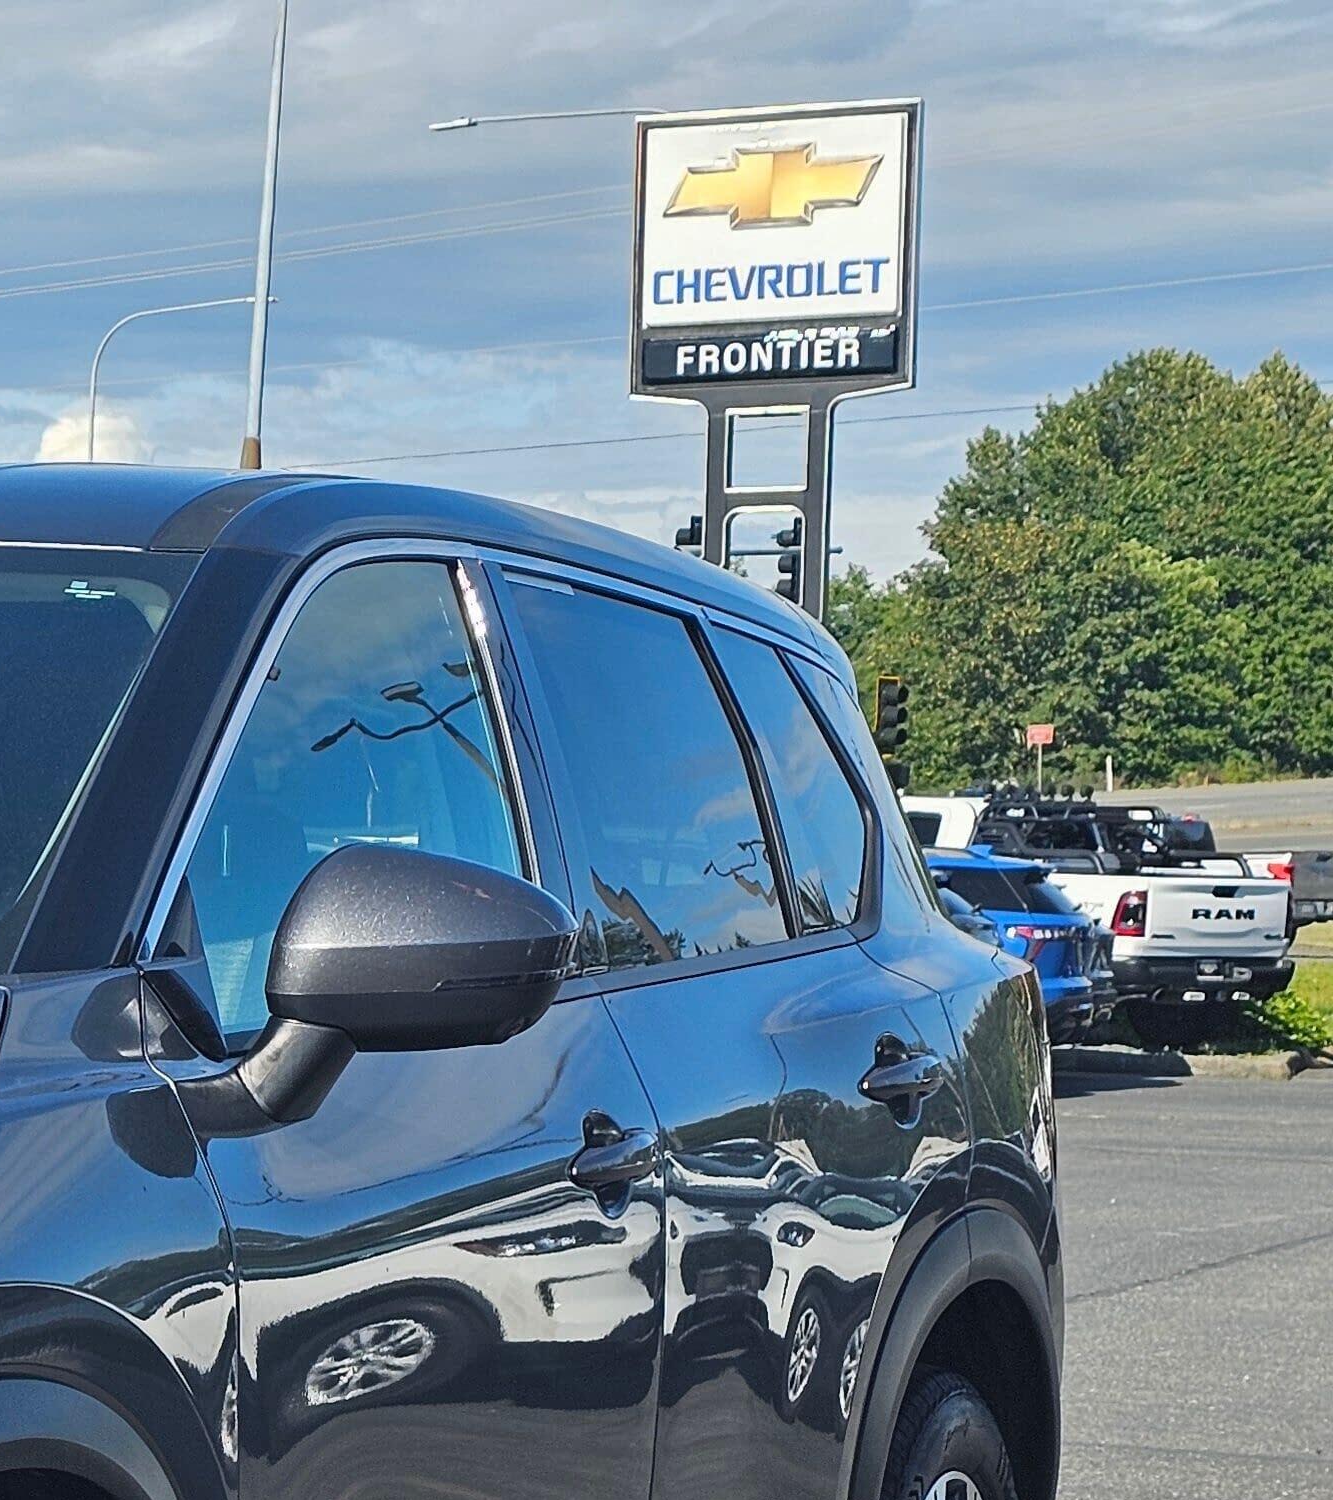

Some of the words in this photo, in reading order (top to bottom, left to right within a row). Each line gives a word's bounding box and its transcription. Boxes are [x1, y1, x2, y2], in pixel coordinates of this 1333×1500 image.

[653, 256, 890, 305] CHEVROLET
[676, 337, 860, 375] FRONTIER
[1191, 908, 1256, 920] RAM
